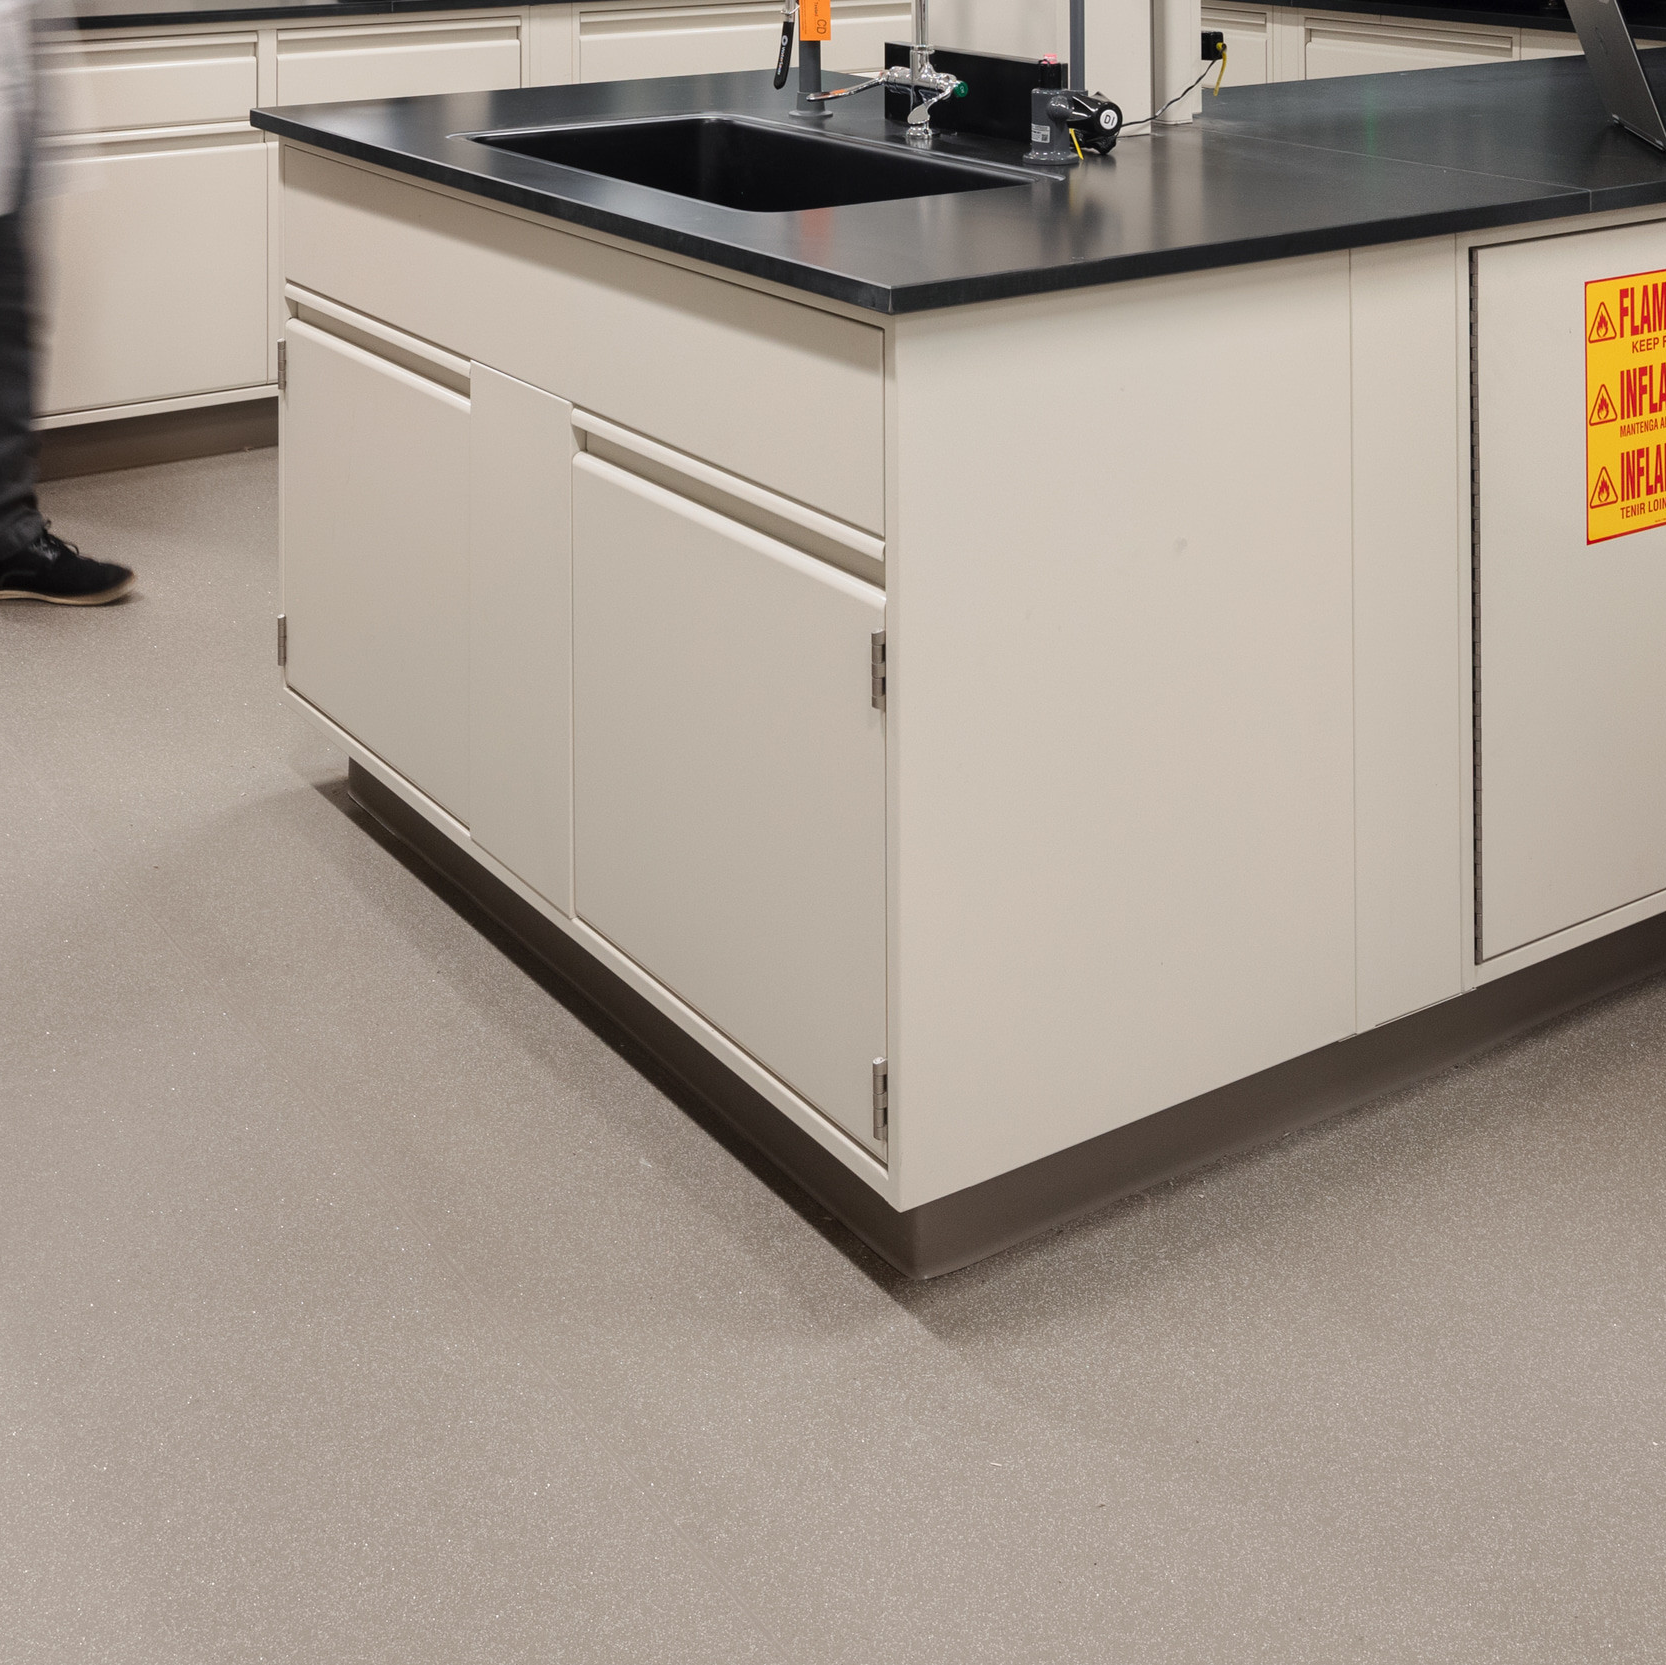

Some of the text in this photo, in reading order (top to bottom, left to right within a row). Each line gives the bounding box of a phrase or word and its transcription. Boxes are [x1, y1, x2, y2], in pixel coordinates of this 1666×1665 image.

[816, 18, 828, 35] CD
[1632, 336, 1660, 354] KEEP
[1620, 419, 1658, 438] MANTENGA
[1620, 501, 1646, 519] TENIR
